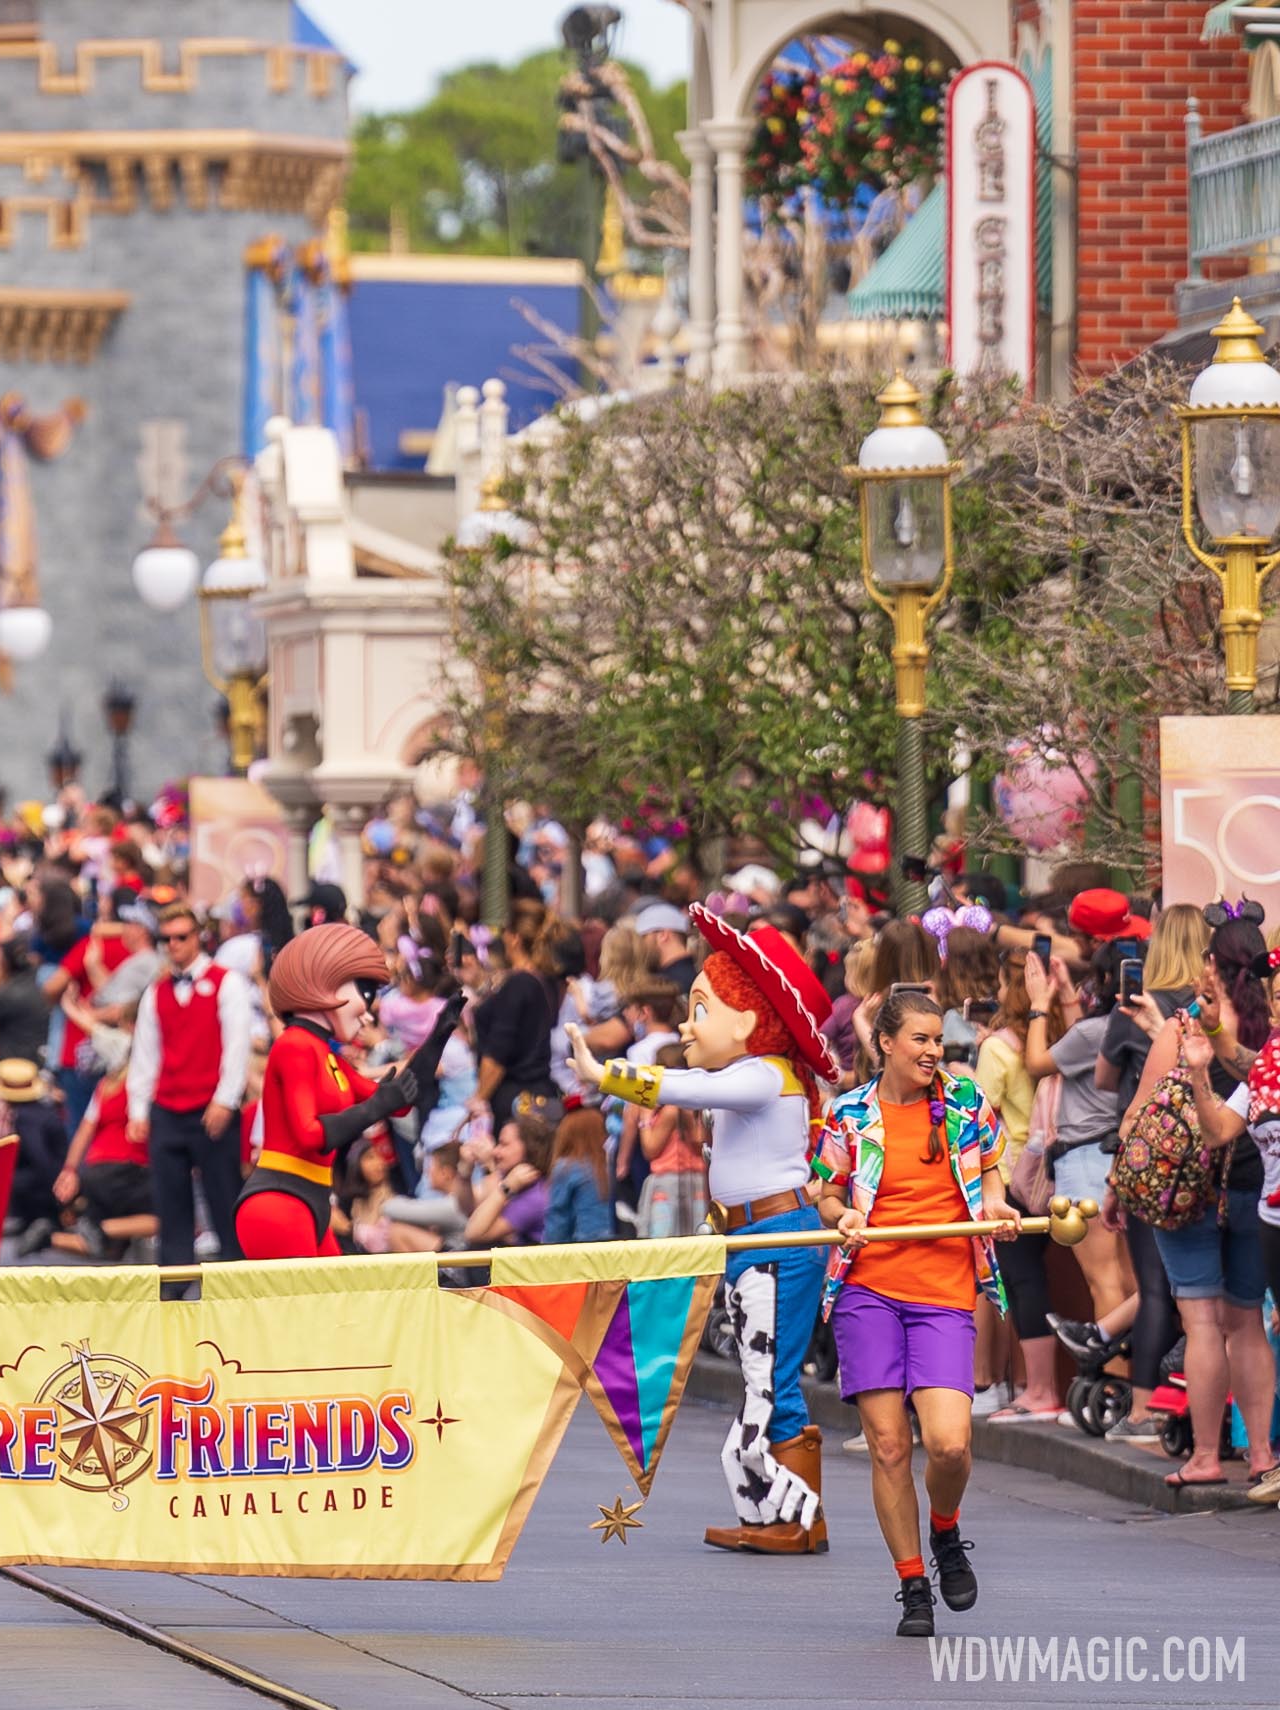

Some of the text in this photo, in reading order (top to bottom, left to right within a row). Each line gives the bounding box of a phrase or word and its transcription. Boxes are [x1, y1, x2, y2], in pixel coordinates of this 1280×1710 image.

[974, 79, 1008, 377] ICE CREA
[136, 1374, 415, 1478] FRIENDS
[108, 1484, 129, 1511] S
[169, 1486, 393, 1519] CAVALCADE
